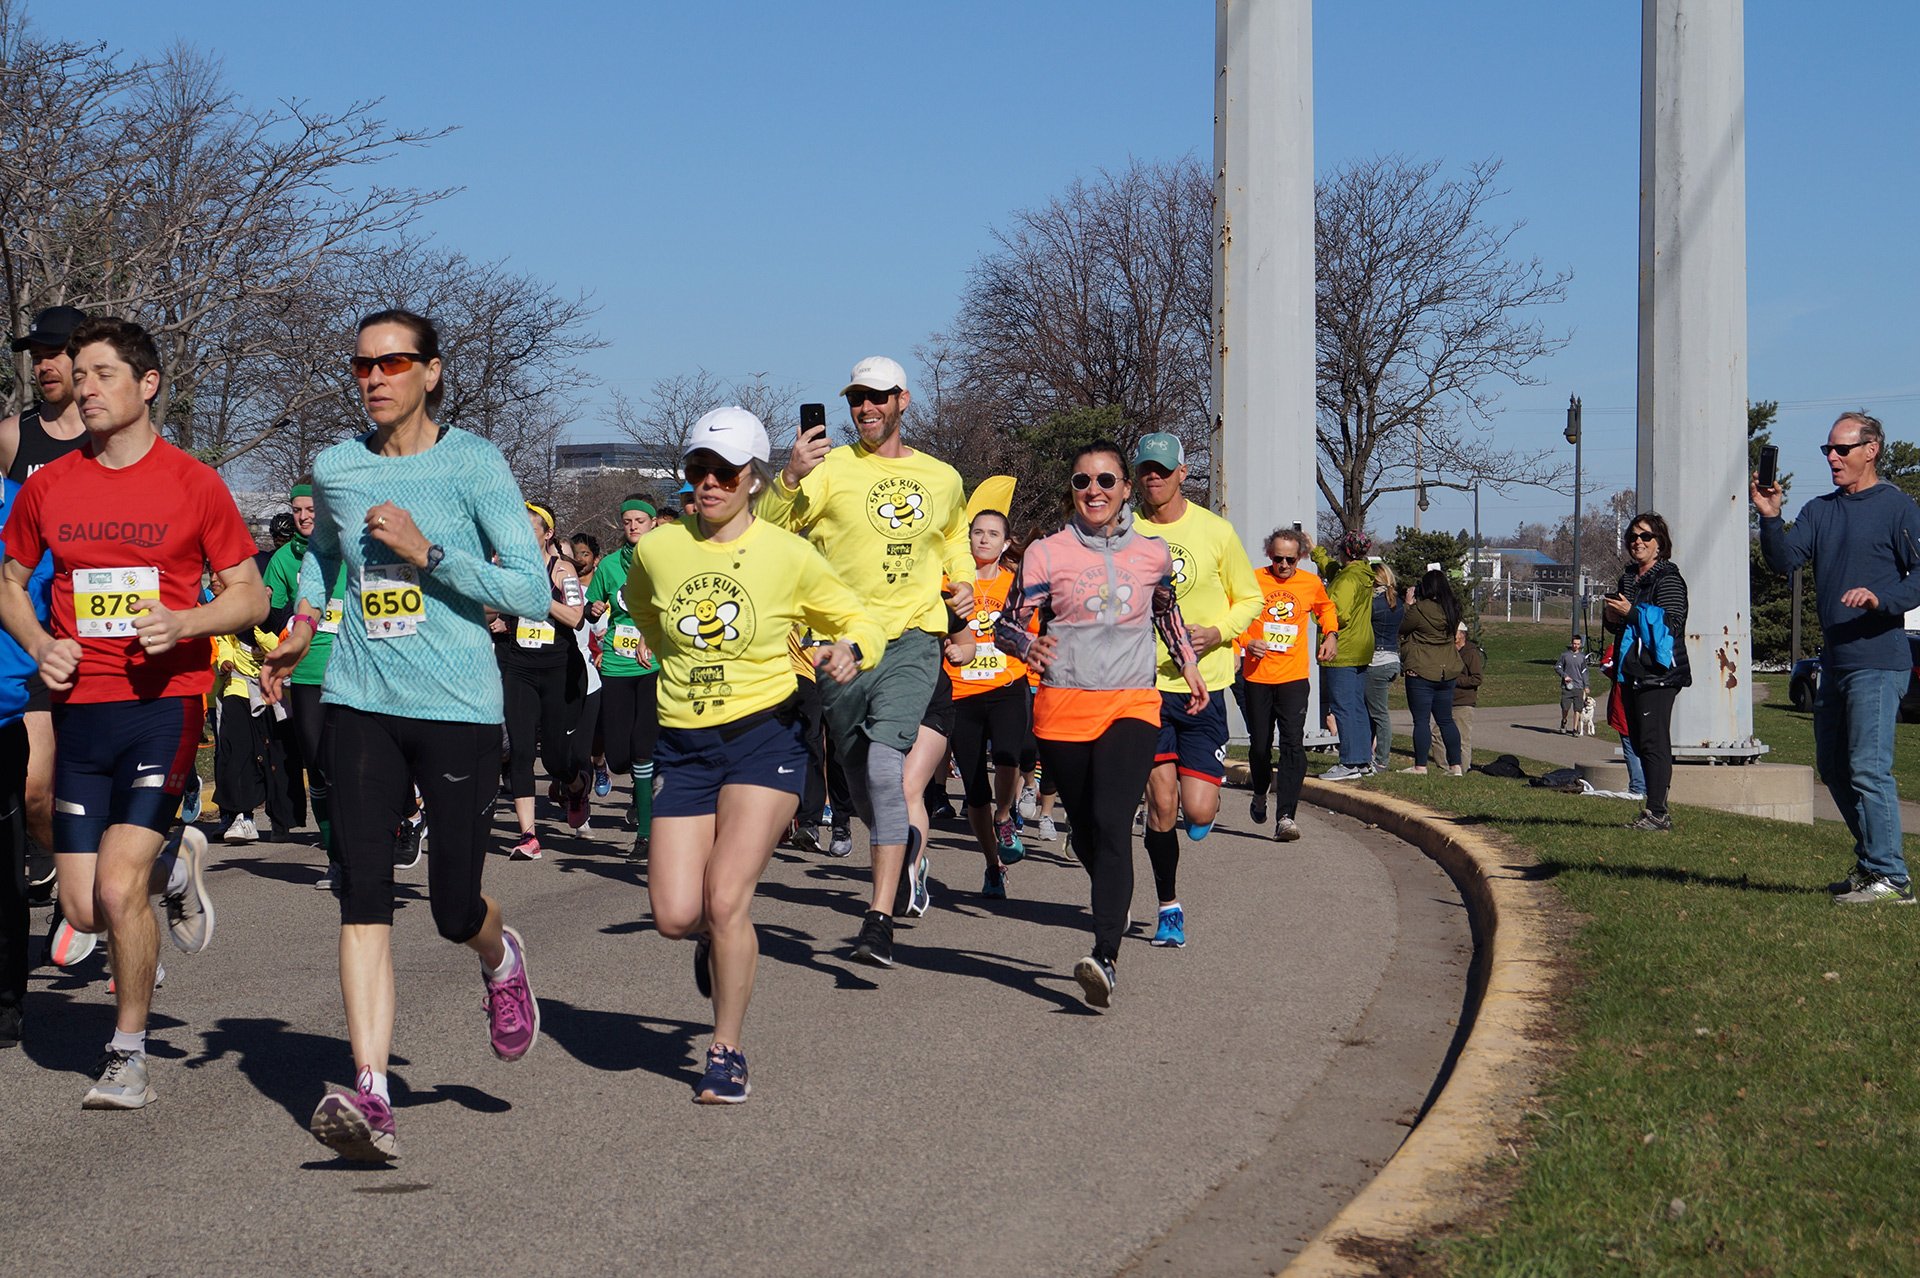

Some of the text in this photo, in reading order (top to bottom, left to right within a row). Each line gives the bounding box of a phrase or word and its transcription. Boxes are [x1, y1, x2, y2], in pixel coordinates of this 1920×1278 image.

[870, 479, 921, 504] 5K BEE RUN
[1086, 567, 1104, 580] BEE
[364, 589, 421, 617] 650
[671, 577, 741, 614] 5K BEE RUN
[90, 593, 142, 617] 878
[528, 628, 541, 639] 21
[1269, 632, 1291, 644] 707
[969, 656, 998, 669] 248
